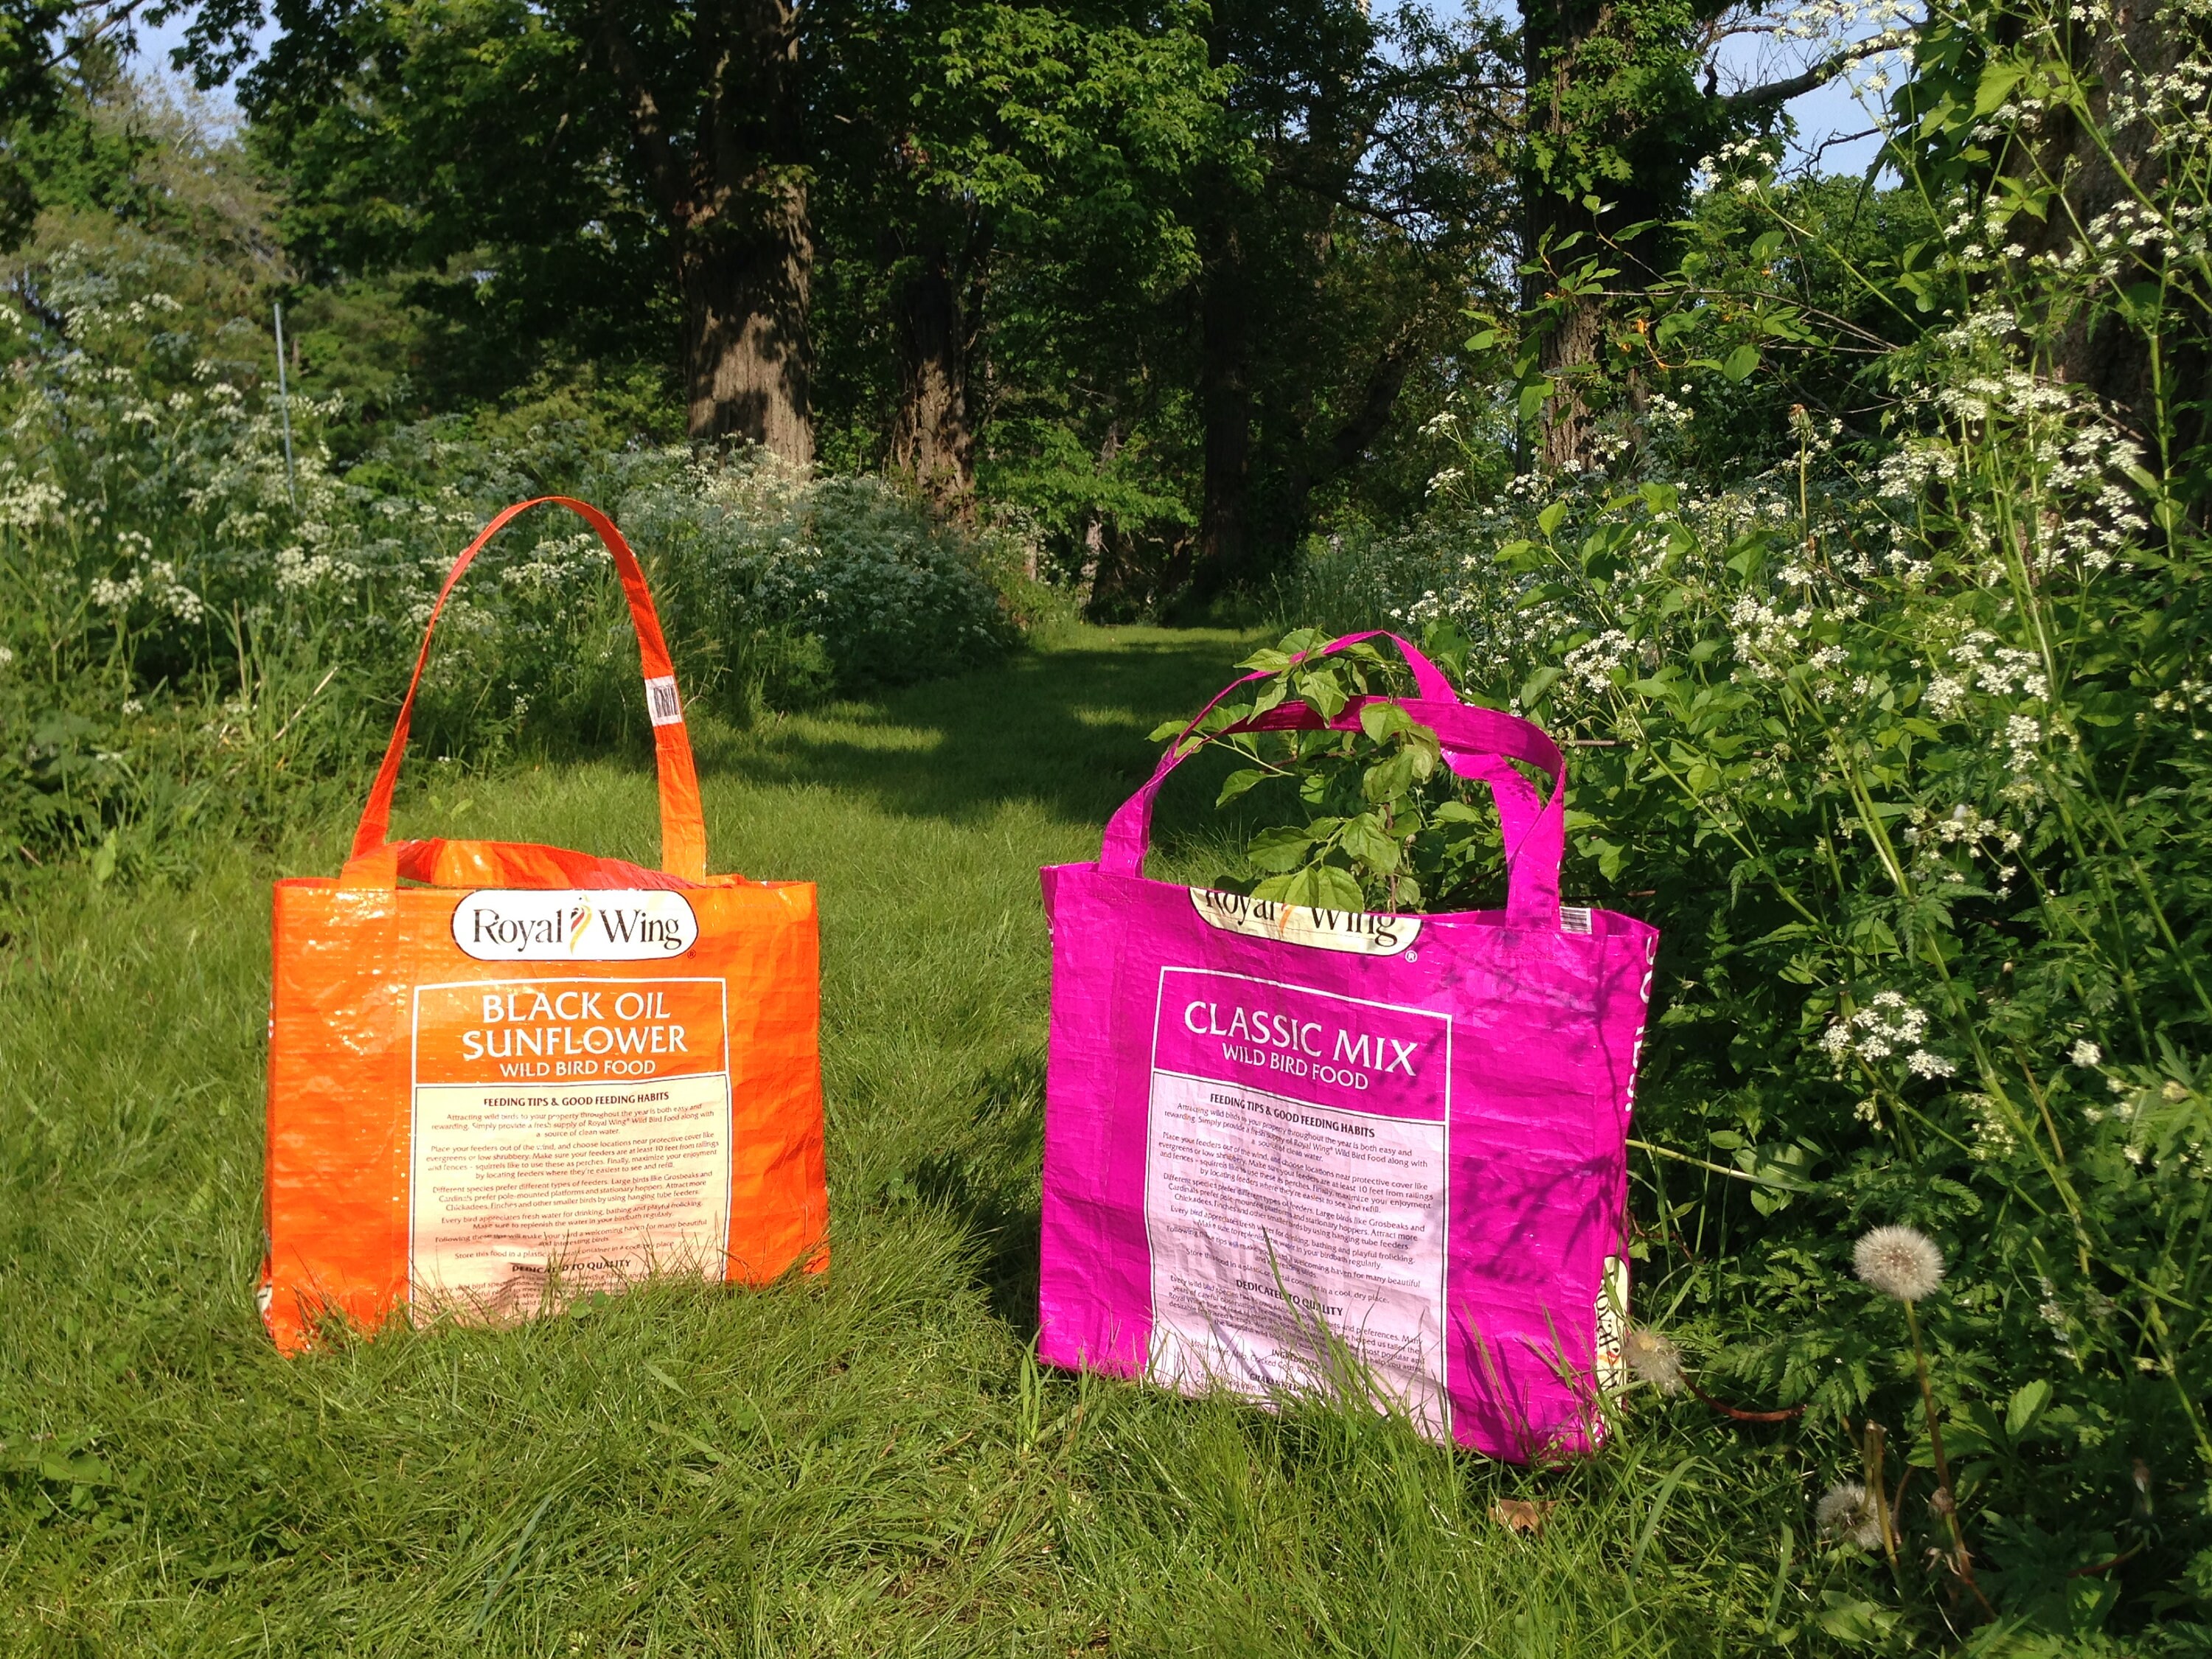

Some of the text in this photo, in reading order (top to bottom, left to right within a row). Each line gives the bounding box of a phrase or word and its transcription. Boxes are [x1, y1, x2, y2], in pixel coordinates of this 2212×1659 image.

[473, 908, 682, 952] Royal Wing
[482, 991, 671, 1023] BLACK OIL
[462, 1025, 688, 1061] SUNFLOWER
[1184, 1001, 1419, 1077] CLASSIC MIX
[499, 1060, 656, 1078] WILD BIRD FOOD
[1222, 1043, 1368, 1091] WILD BIRD FOOD
[484, 1097, 526, 1107] FEEDING
[527, 1097, 549, 1106] TIPS
[562, 1096, 593, 1106] GOOD
[595, 1094, 636, 1105] FEEDING
[637, 1091, 669, 1103] HABITS
[447, 1113, 482, 1121] Attracting
[580, 1111, 619, 1119] throughout
[657, 1106, 672, 1114] both
[1210, 1093, 1245, 1109] FEEDING
[1246, 1101, 1264, 1113] TIPS
[1273, 1108, 1299, 1123] GOOD
[1301, 1116, 1339, 1131] FEEDING
[1340, 1123, 1375, 1138] HABITS
[588, 1119, 607, 1127] Royal
[452, 1145, 469, 1153] your
[649, 1135, 683, 1145] protective
[1197, 1116, 1221, 1127] Simply
[1335, 1148, 1350, 1158] Wild
[1352, 1151, 1366, 1161] Bird
[1367, 1155, 1386, 1163] Food
[1388, 1158, 1409, 1168] along
[1287, 1129, 1324, 1142] throughout
[1325, 1135, 1336, 1144] the
[1338, 1139, 1352, 1148] year
[1360, 1144, 1377, 1152] both
[1379, 1147, 1396, 1156] easy
[1398, 1149, 1412, 1157] and
[476, 1162, 505, 1172] squirrels
[1163, 1131, 1180, 1142] Place
[1196, 1139, 1221, 1150] feeders
[1335, 1172, 1350, 1180] near
[1352, 1175, 1390, 1186] protective
[1391, 1181, 1413, 1189] cover
[1158, 1142, 1193, 1153] evergreens
[1340, 1183, 1356, 1192] least
[1369, 1187, 1383, 1195] feet
[1385, 1189, 1404, 1198] from
[1405, 1192, 1433, 1201] railings
[551, 1182, 571, 1191] types
[611, 1178, 631, 1186] Large
[600, 1186, 634, 1194] stationary
[1210, 1170, 1235, 1182] locating
[1335, 1200, 1346, 1208] see
[608, 1194, 626, 1203] using
[627, 1192, 655, 1201] hanging
[1390, 1200, 1431, 1209] enjoyment
[606, 1207, 631, 1215] bathing
[1315, 1208, 1335, 1219] Large
[1336, 1213, 1352, 1223] birds
[1354, 1217, 1367, 1225] like
[1368, 1219, 1409, 1231] Grosbeaks
[521, 1221, 553, 1229] replenish
[1312, 1228, 1331, 1239] using
[1332, 1231, 1360, 1245] hanging
[1361, 1237, 1378, 1246] tube
[1371, 1229, 1396, 1239] Attract
[1397, 1234, 1418, 1242] more
[1352, 1249, 1377, 1259] playful
[512, 1262, 569, 1274] DEDICATD
[587, 1259, 631, 1270] QUALITY
[1366, 1274, 1420, 1288] many beautiful
[1354, 1292, 1366, 1301] dry
